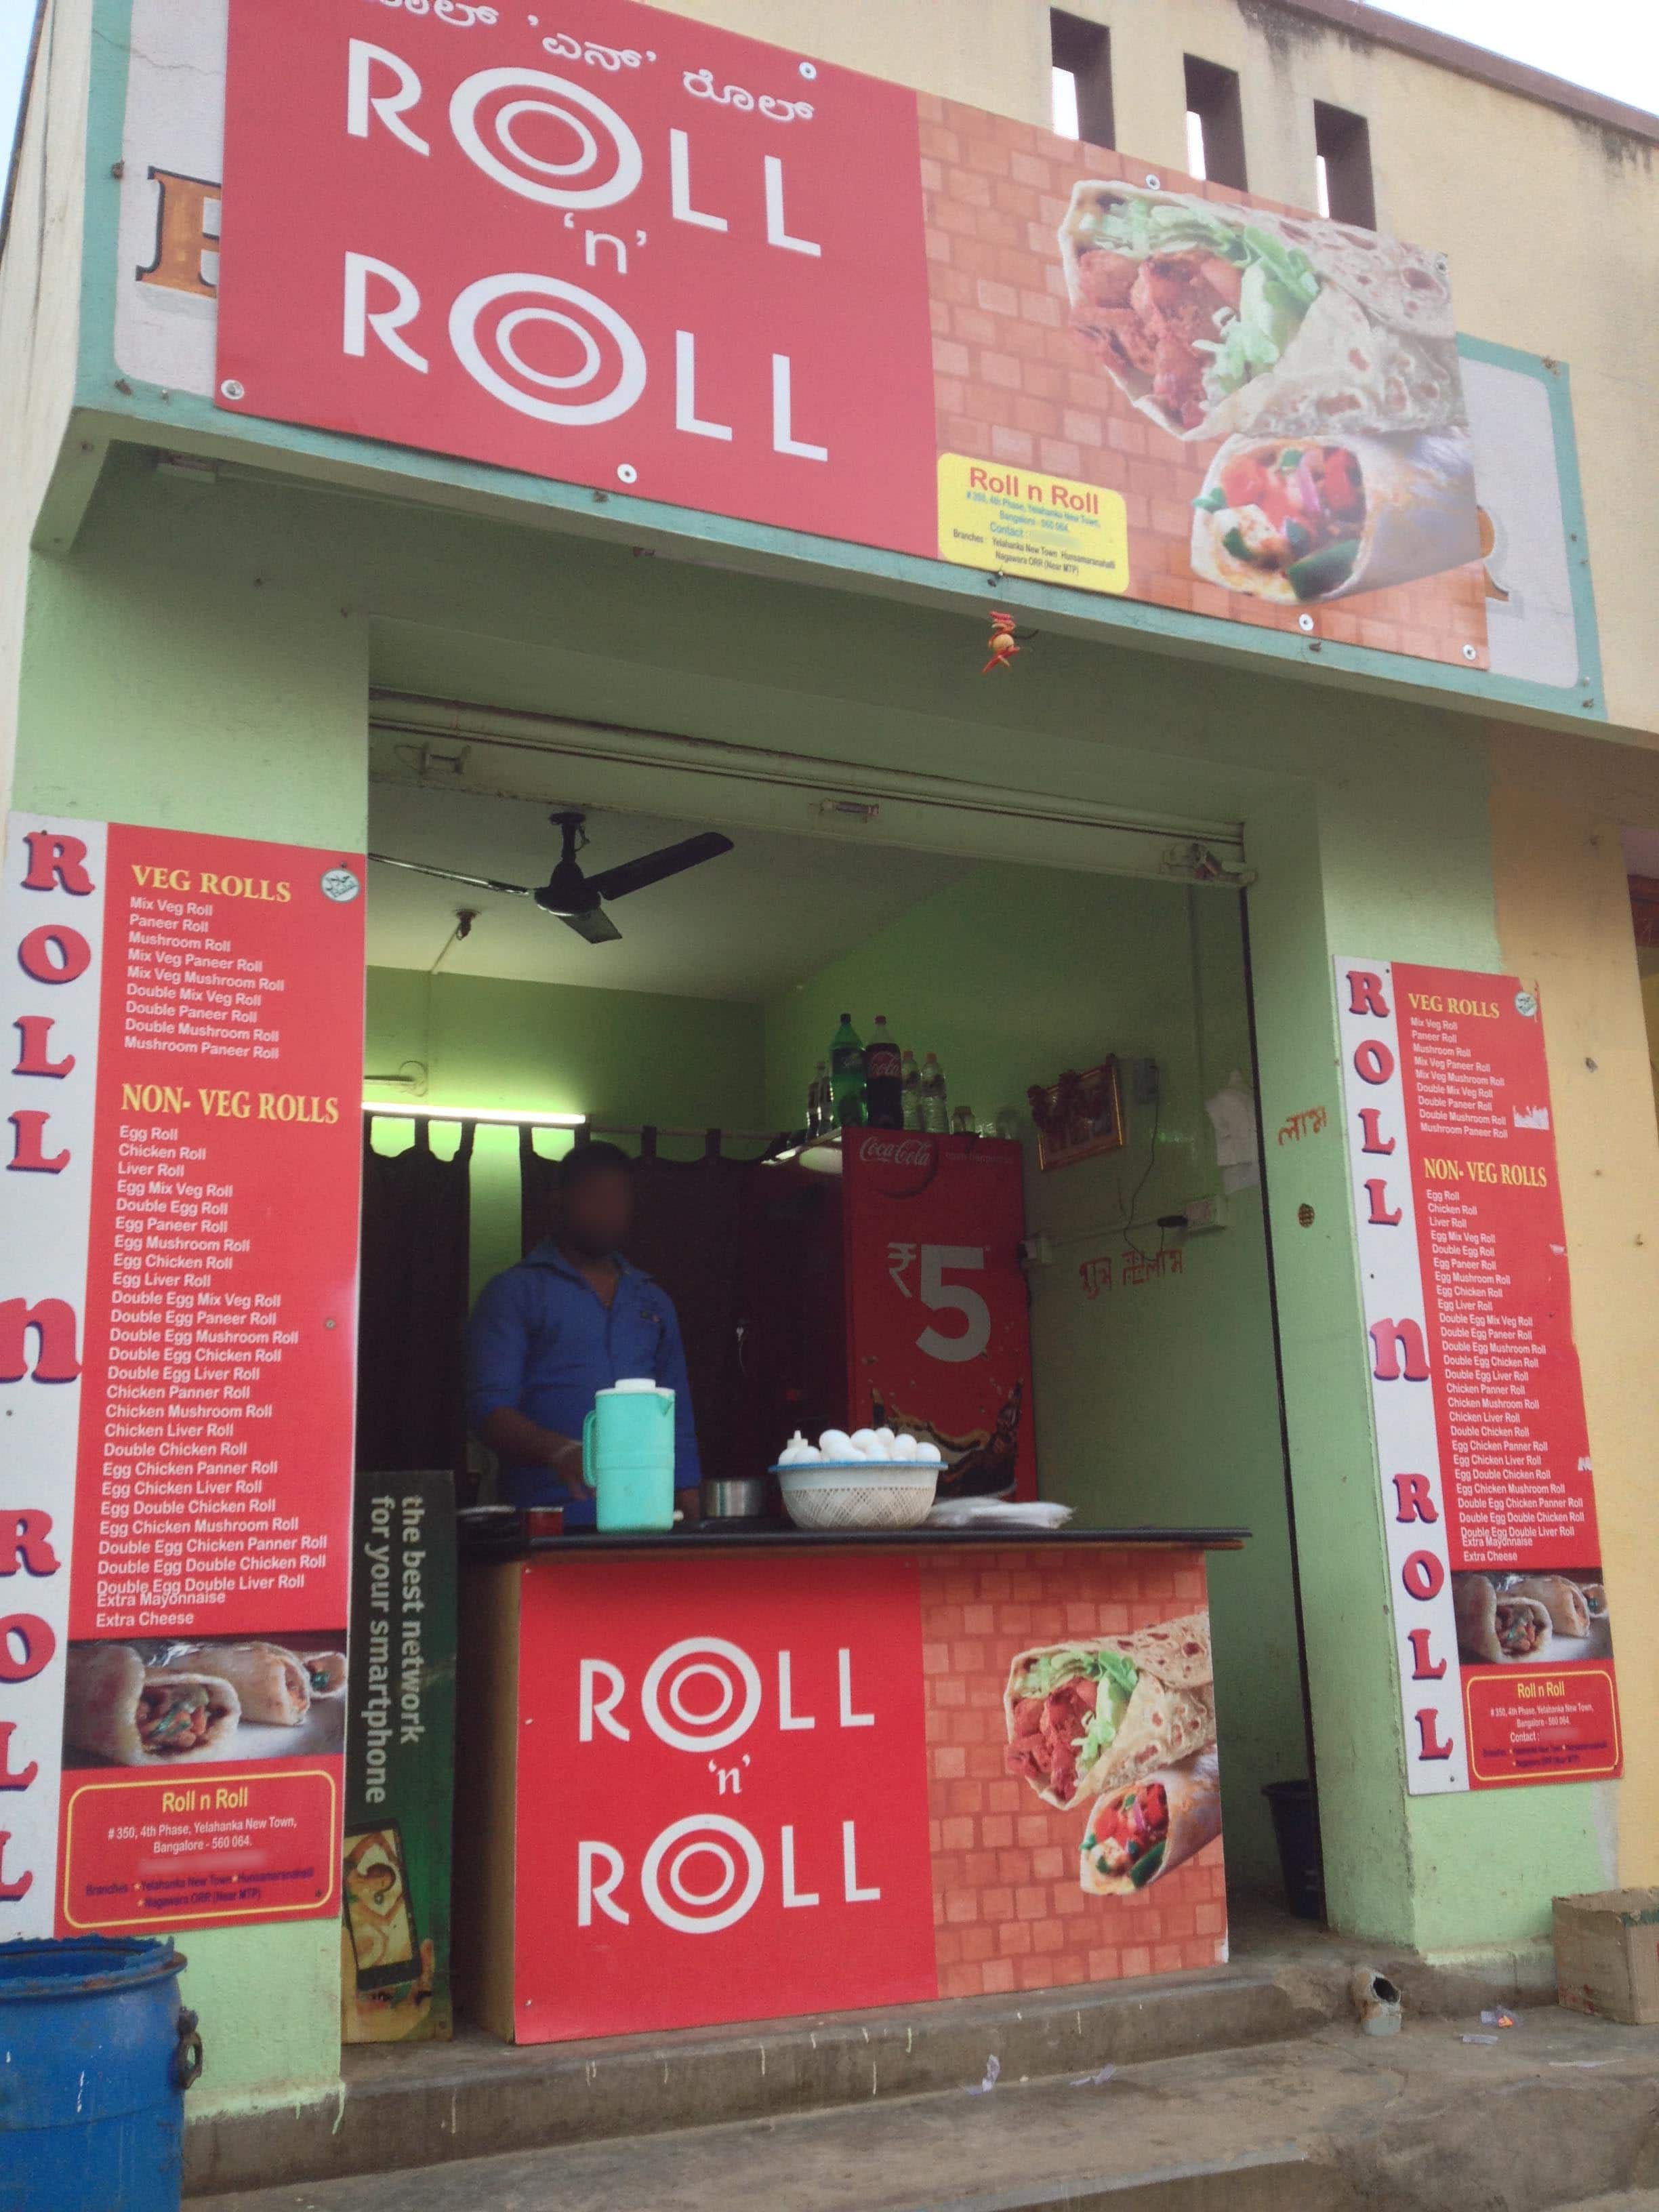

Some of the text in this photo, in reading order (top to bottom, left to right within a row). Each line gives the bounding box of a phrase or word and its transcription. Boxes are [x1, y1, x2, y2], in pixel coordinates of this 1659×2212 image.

[347, 37, 821, 256] ROLL
[343, 251, 827, 461] ROLL
[970, 466, 1019, 497] Roll
[1027, 485, 1042, 502] n
[1051, 484, 1099, 514] Roll
[133, 867, 190, 893] VEG
[201, 874, 291, 903] ROLLS
[129, 897, 213, 916] Mix Veg Roll
[129, 914, 209, 933] Paneer Roll
[128, 931, 230, 952] Mushroom Roll
[127, 949, 262, 972] Mix Veg Paneer Roll
[127, 966, 284, 991] Mix Veg Mushroom Roll
[6, 831, 96, 1174] ROLL
[126, 983, 261, 1006] Double Mix Veg Roll
[125, 1002, 257, 1023] Double Paneer Roll
[1408, 993, 1499, 1019] VEG ROLLS
[125, 1019, 279, 1042] Double Mushroom Roll
[1412, 1031, 1456, 1044] Paneer Roll
[124, 1036, 279, 1059] Mushroom Paneer Roll
[1412, 1043, 1471, 1057] Mushroom Roll
[199, 1089, 249, 1118] VEG
[259, 1093, 338, 1124] ROLLS
[1346, 970, 1402, 1226] ROLL
[119, 1126, 178, 1143] Egg Roll
[118, 1143, 206, 1161] Chicken Roll
[117, 1162, 184, 1177] Liver Roll
[1467, 1162, 1497, 1183] VEG
[1500, 1165, 1547, 1187] ROLLS
[117, 1180, 233, 1199] Egg Mix Veg Roll
[1427, 1203, 1477, 1216] Chicken Roll
[115, 1216, 228, 1233] Egg Paneer Roll
[1429, 1217, 1467, 1229] Liver Roll
[114, 1235, 250, 1252] Egg Mushroom Roll
[0, 1296, 83, 1385] n
[1369, 1317, 1431, 1382] n
[108, 1348, 282, 1364] Double Egg Chicken Roll
[106, 1385, 250, 1399] Chicken Panner Roll
[1449, 1412, 1520, 1422] Chicken Liver Roll
[104, 1423, 233, 1437] Chicken Liver Roll
[1453, 1455, 1541, 1467] Egg Chicken Liver Roll
[98, 1536, 327, 1556] Double Egg Chicken Panner Roll
[1463, 1551, 1517, 1562] Extra Cheese
[96, 1591, 226, 1609] Extra Mayonnaise
[96, 1612, 194, 1627] Extra Cheese
[400, 1496, 426, 1744] the best network
[1393, 1473, 1454, 1761] ROLL
[361, 1496, 395, 1803] for your smartphone
[579, 1637, 874, 1753] ROLL
[1517, 1681, 1565, 1698] Roll n Roll
[1510, 1731, 1536, 1742] Contact
[162, 1787, 248, 1812] Roll n Roll
[153, 1840, 203, 1855] Bangalore
[211, 1837, 229, 1849] 560
[578, 1814, 880, 1933] ROLL
